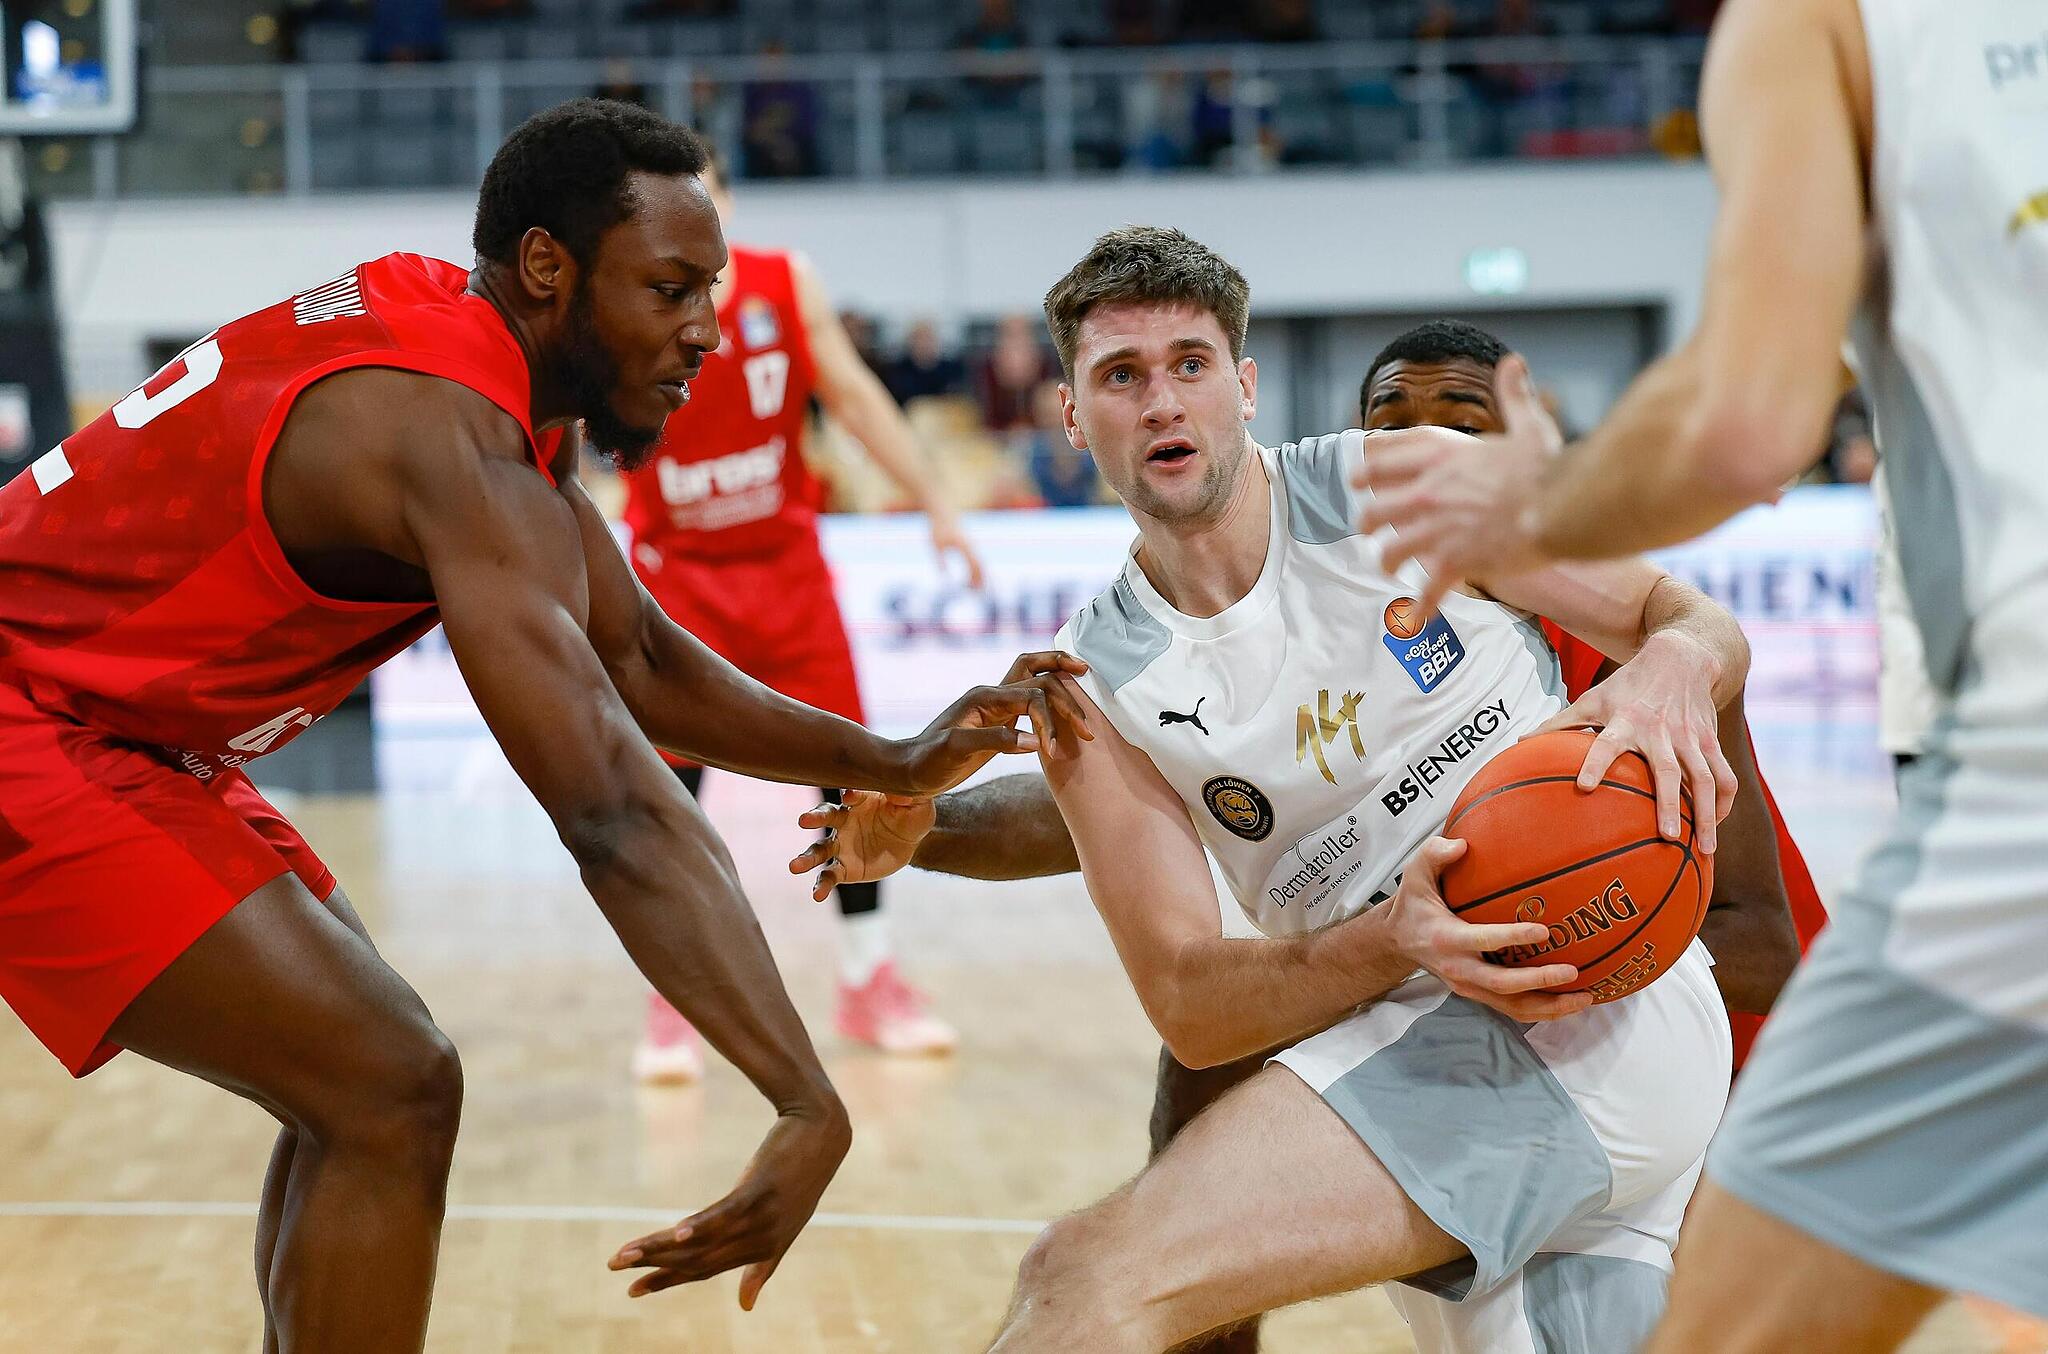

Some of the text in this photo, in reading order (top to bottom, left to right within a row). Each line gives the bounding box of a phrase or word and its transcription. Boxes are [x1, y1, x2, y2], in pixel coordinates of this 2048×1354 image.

[1421, 632, 1450, 659] Credit
[1418, 644, 1459, 686] BBL
[1295, 689, 1367, 787] 14
[1223, 779, 1253, 794] LÖWEN
[1330, 871, 1349, 890] SINCE
[1348, 860, 1362, 873] 1999
